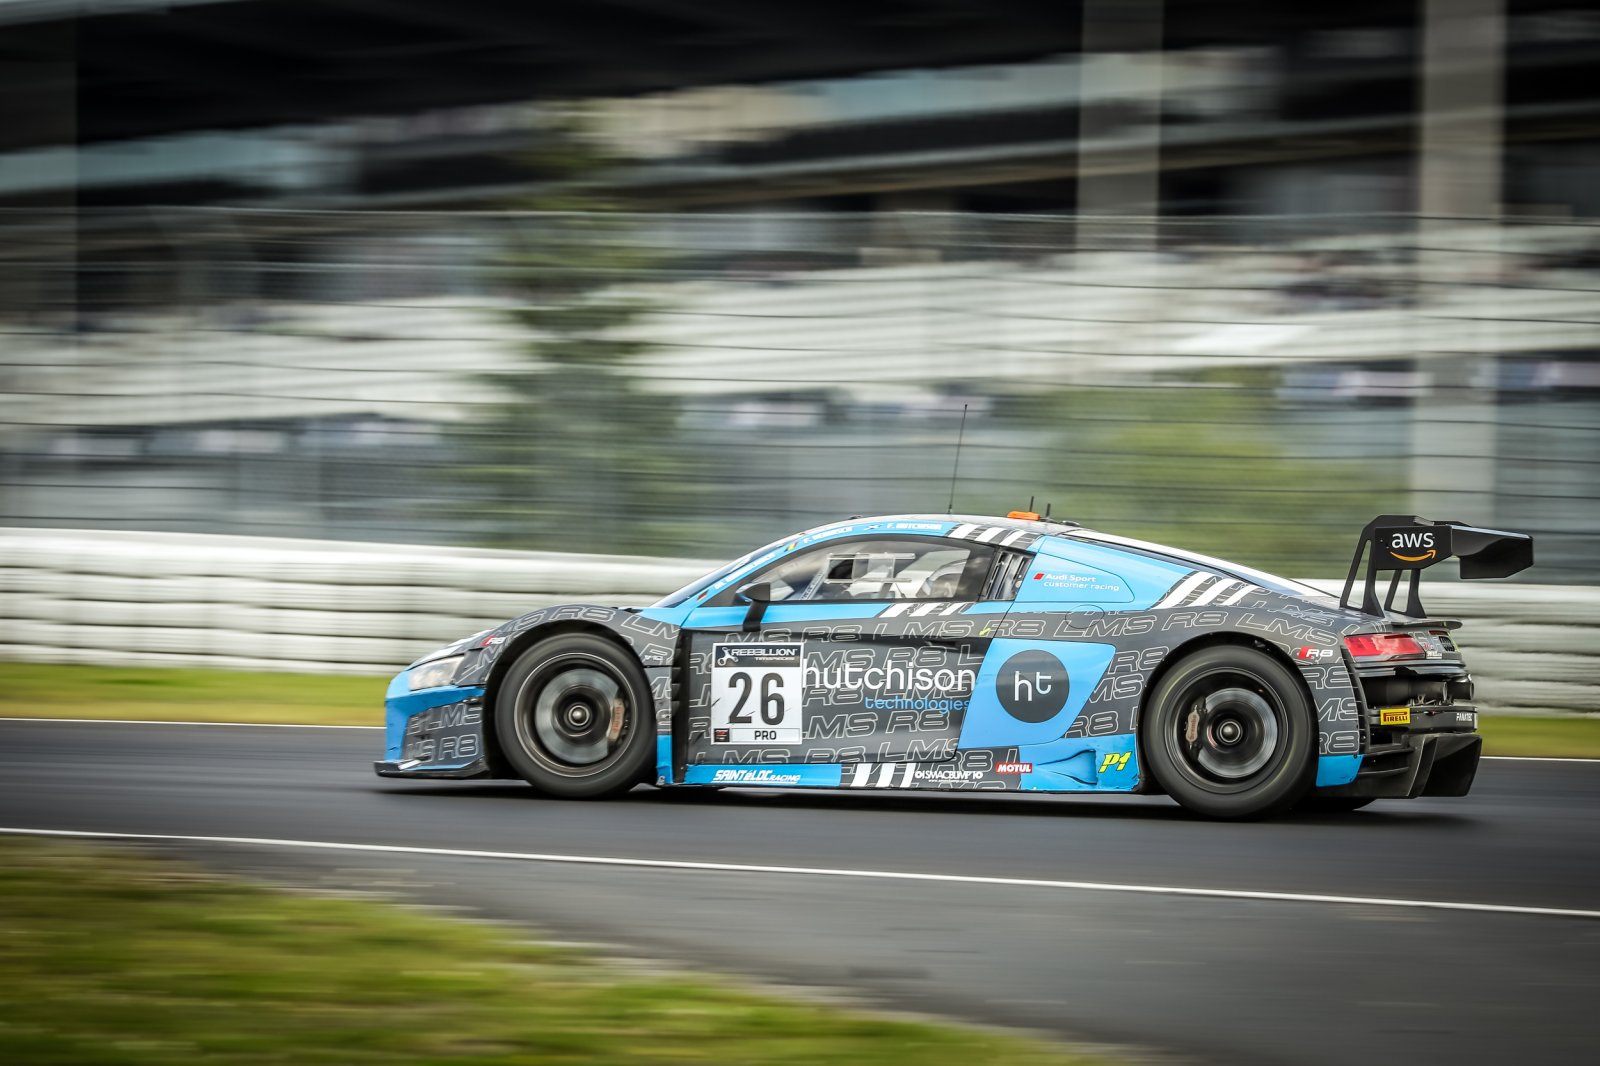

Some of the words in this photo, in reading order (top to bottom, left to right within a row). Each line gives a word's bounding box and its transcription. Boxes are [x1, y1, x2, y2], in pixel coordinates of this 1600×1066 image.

[1391, 532, 1434, 548] aws
[1044, 581, 1088, 589] customer
[1090, 583, 1120, 591] racing
[1070, 574, 1096, 583] Sport
[549, 606, 616, 622] R8
[980, 619, 1047, 637] R8
[1053, 614, 1157, 638] LMS
[1161, 611, 1229, 631] R8
[1235, 612, 1339, 647] LMS
[731, 648, 796, 656] REBELLION
[882, 645, 947, 670] R8
[1107, 646, 1170, 675] R8
[1305, 649, 1334, 657] R8
[802, 658, 976, 691] hutchison
[802, 684, 864, 707] R8
[1014, 671, 1052, 701] ht
[728, 671, 784, 725] 26
[864, 696, 970, 714] technologies
[802, 712, 878, 740] MS
[886, 709, 950, 734] R8
[1383, 711, 1408, 722] PIRELLI
[754, 730, 777, 740] PRO
[439, 733, 479, 760] R8
[997, 763, 1032, 773] MOTUL
[1099, 751, 1133, 773] P1
